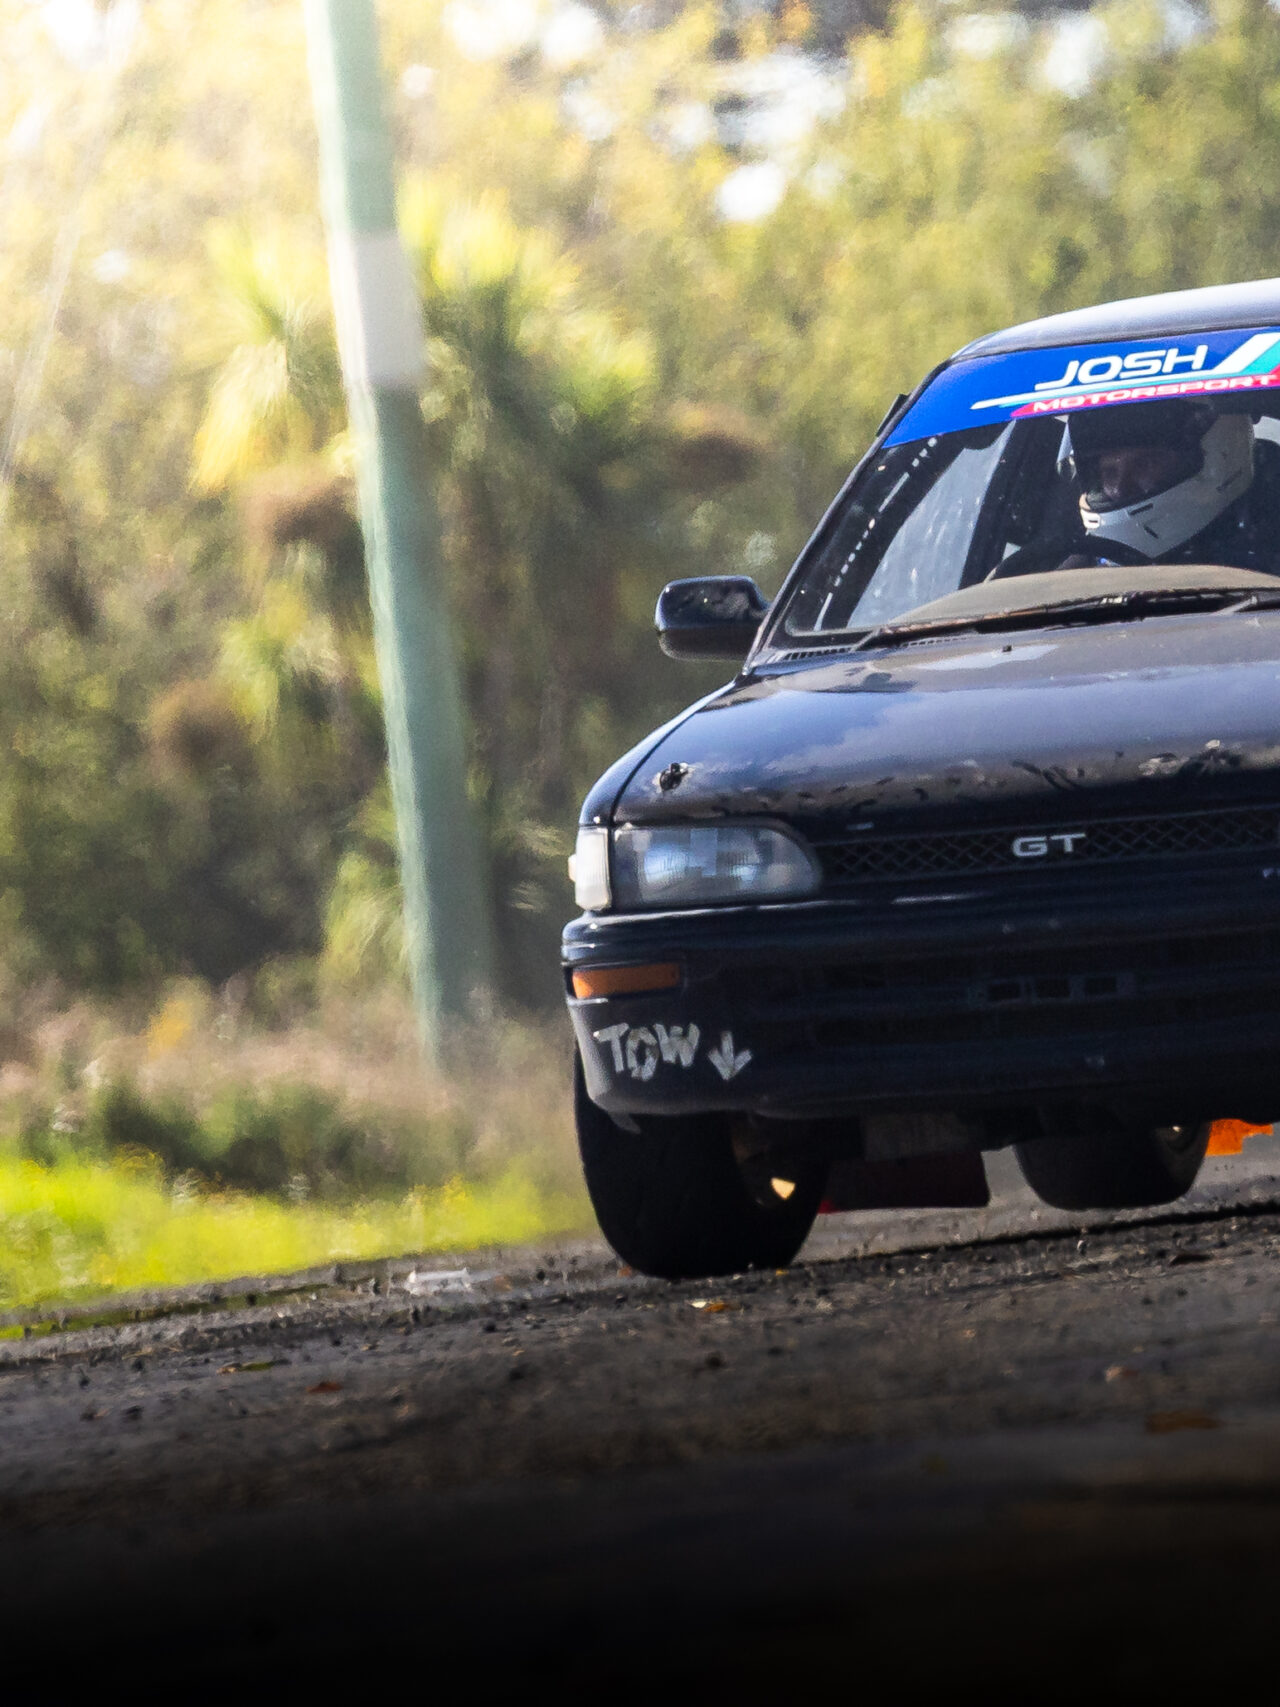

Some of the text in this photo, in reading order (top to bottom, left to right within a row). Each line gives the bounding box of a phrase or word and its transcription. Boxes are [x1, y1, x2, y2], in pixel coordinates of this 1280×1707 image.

[1035, 344, 1208, 391] JOSH
[1032, 374, 1278, 412] MOTORSPORT
[1012, 833, 1086, 857] GT
[592, 1022, 700, 1081] TOW
